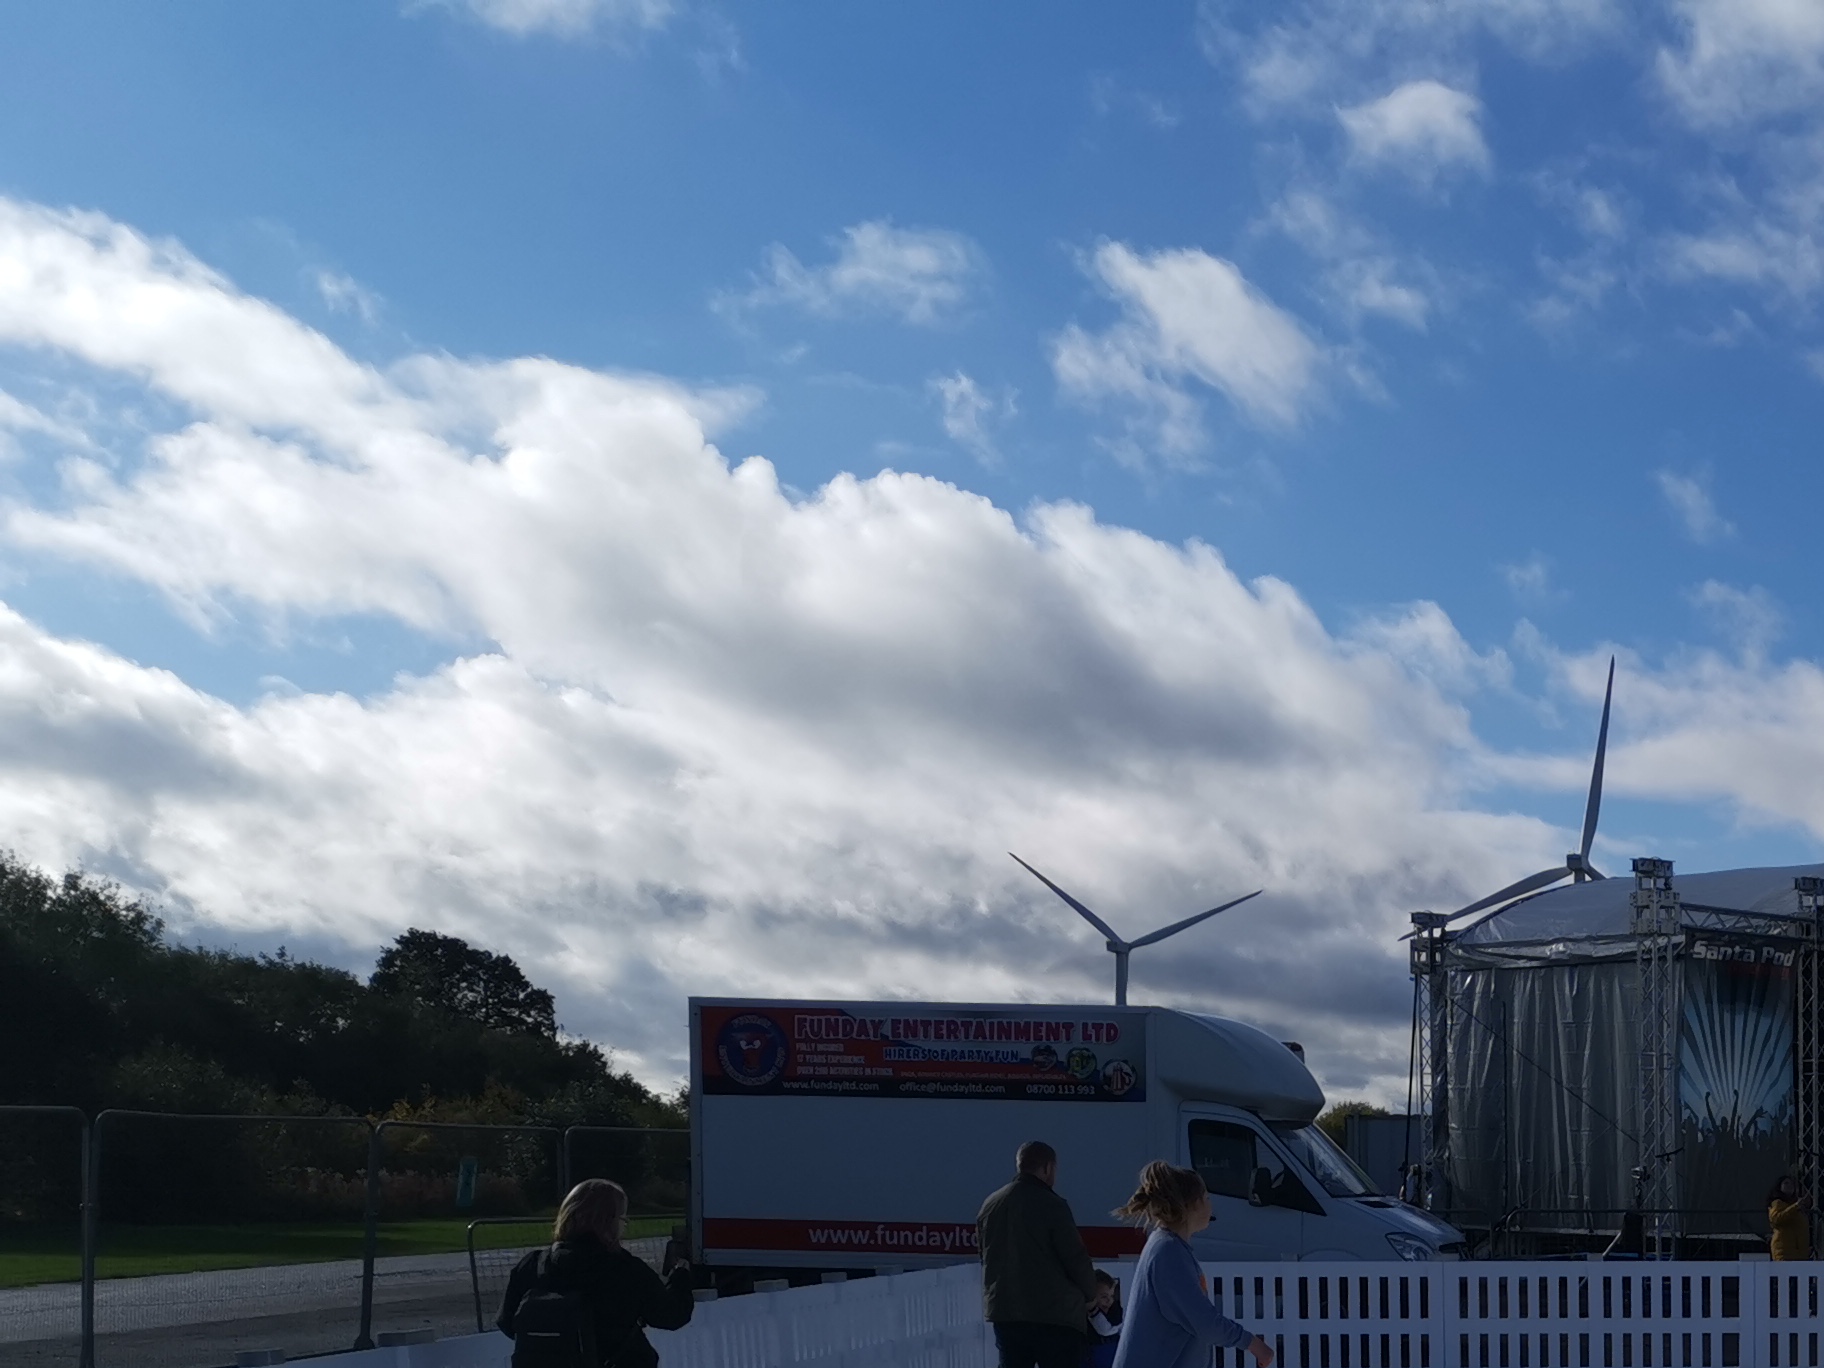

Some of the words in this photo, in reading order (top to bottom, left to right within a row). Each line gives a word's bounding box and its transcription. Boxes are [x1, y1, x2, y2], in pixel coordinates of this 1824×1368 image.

[1692, 940, 1755, 963] Santa
[1761, 946, 1796, 967] Pod
[794, 1015, 886, 1040] FUNDAY
[890, 1018, 1076, 1043] ENTERTAINMENT
[1081, 1021, 1120, 1044] LTD
[883, 1047, 928, 1061] HIRERS
[932, 1048, 947, 1061] OF
[950, 1049, 990, 1063] PARTY
[995, 1050, 1020, 1063] FUN
[782, 1079, 879, 1091] www.fundayltd.com
[899, 1081, 1006, 1094] office@fundayltd.com
[1026, 1084, 1056, 1094] 08700
[1058, 1084, 1075, 1094] 113
